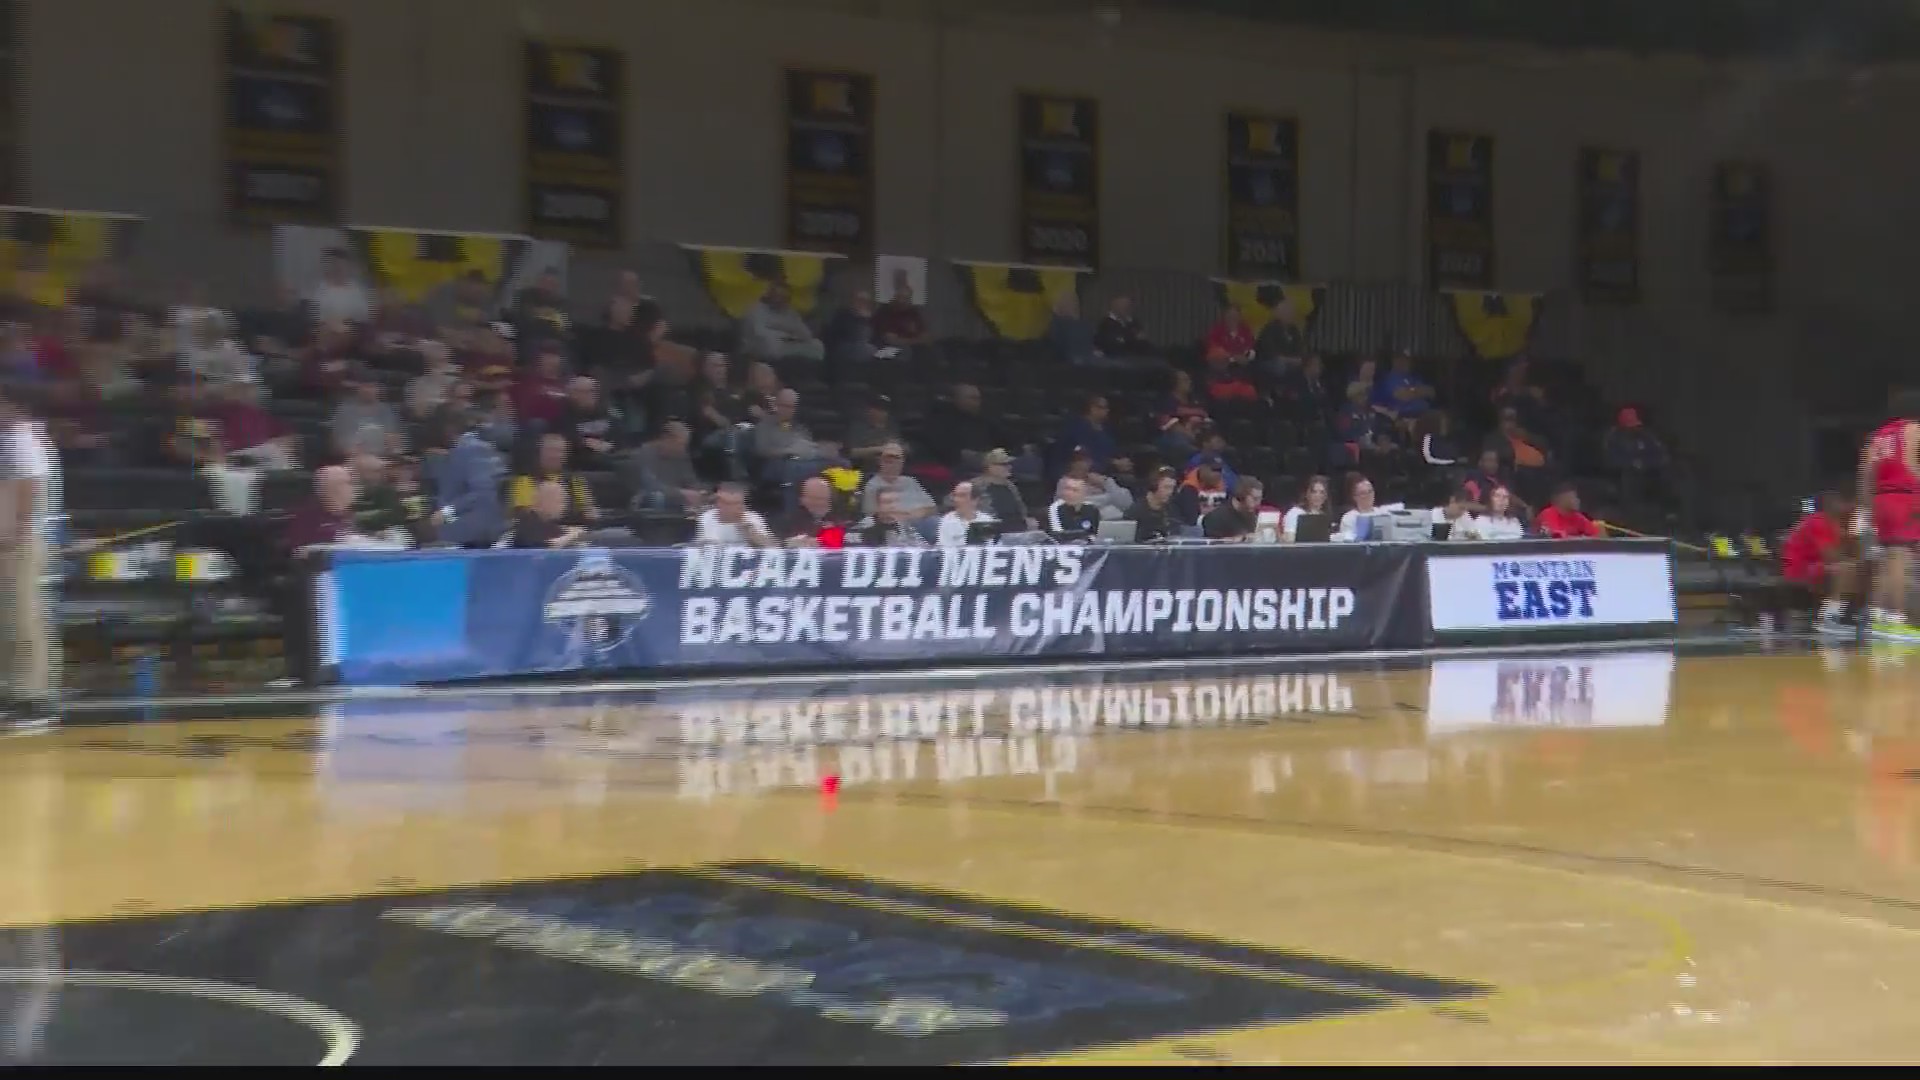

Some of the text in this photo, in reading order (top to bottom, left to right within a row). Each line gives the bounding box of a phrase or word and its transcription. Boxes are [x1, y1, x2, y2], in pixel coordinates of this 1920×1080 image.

[679, 546, 822, 589] NCAA
[841, 546, 923, 588] DII
[938, 545, 1084, 587] MEN'S
[680, 593, 997, 644] BASKETBALL
[1011, 588, 1354, 638] CHAMPIONSHIP
[1493, 580, 1599, 620] EAST
